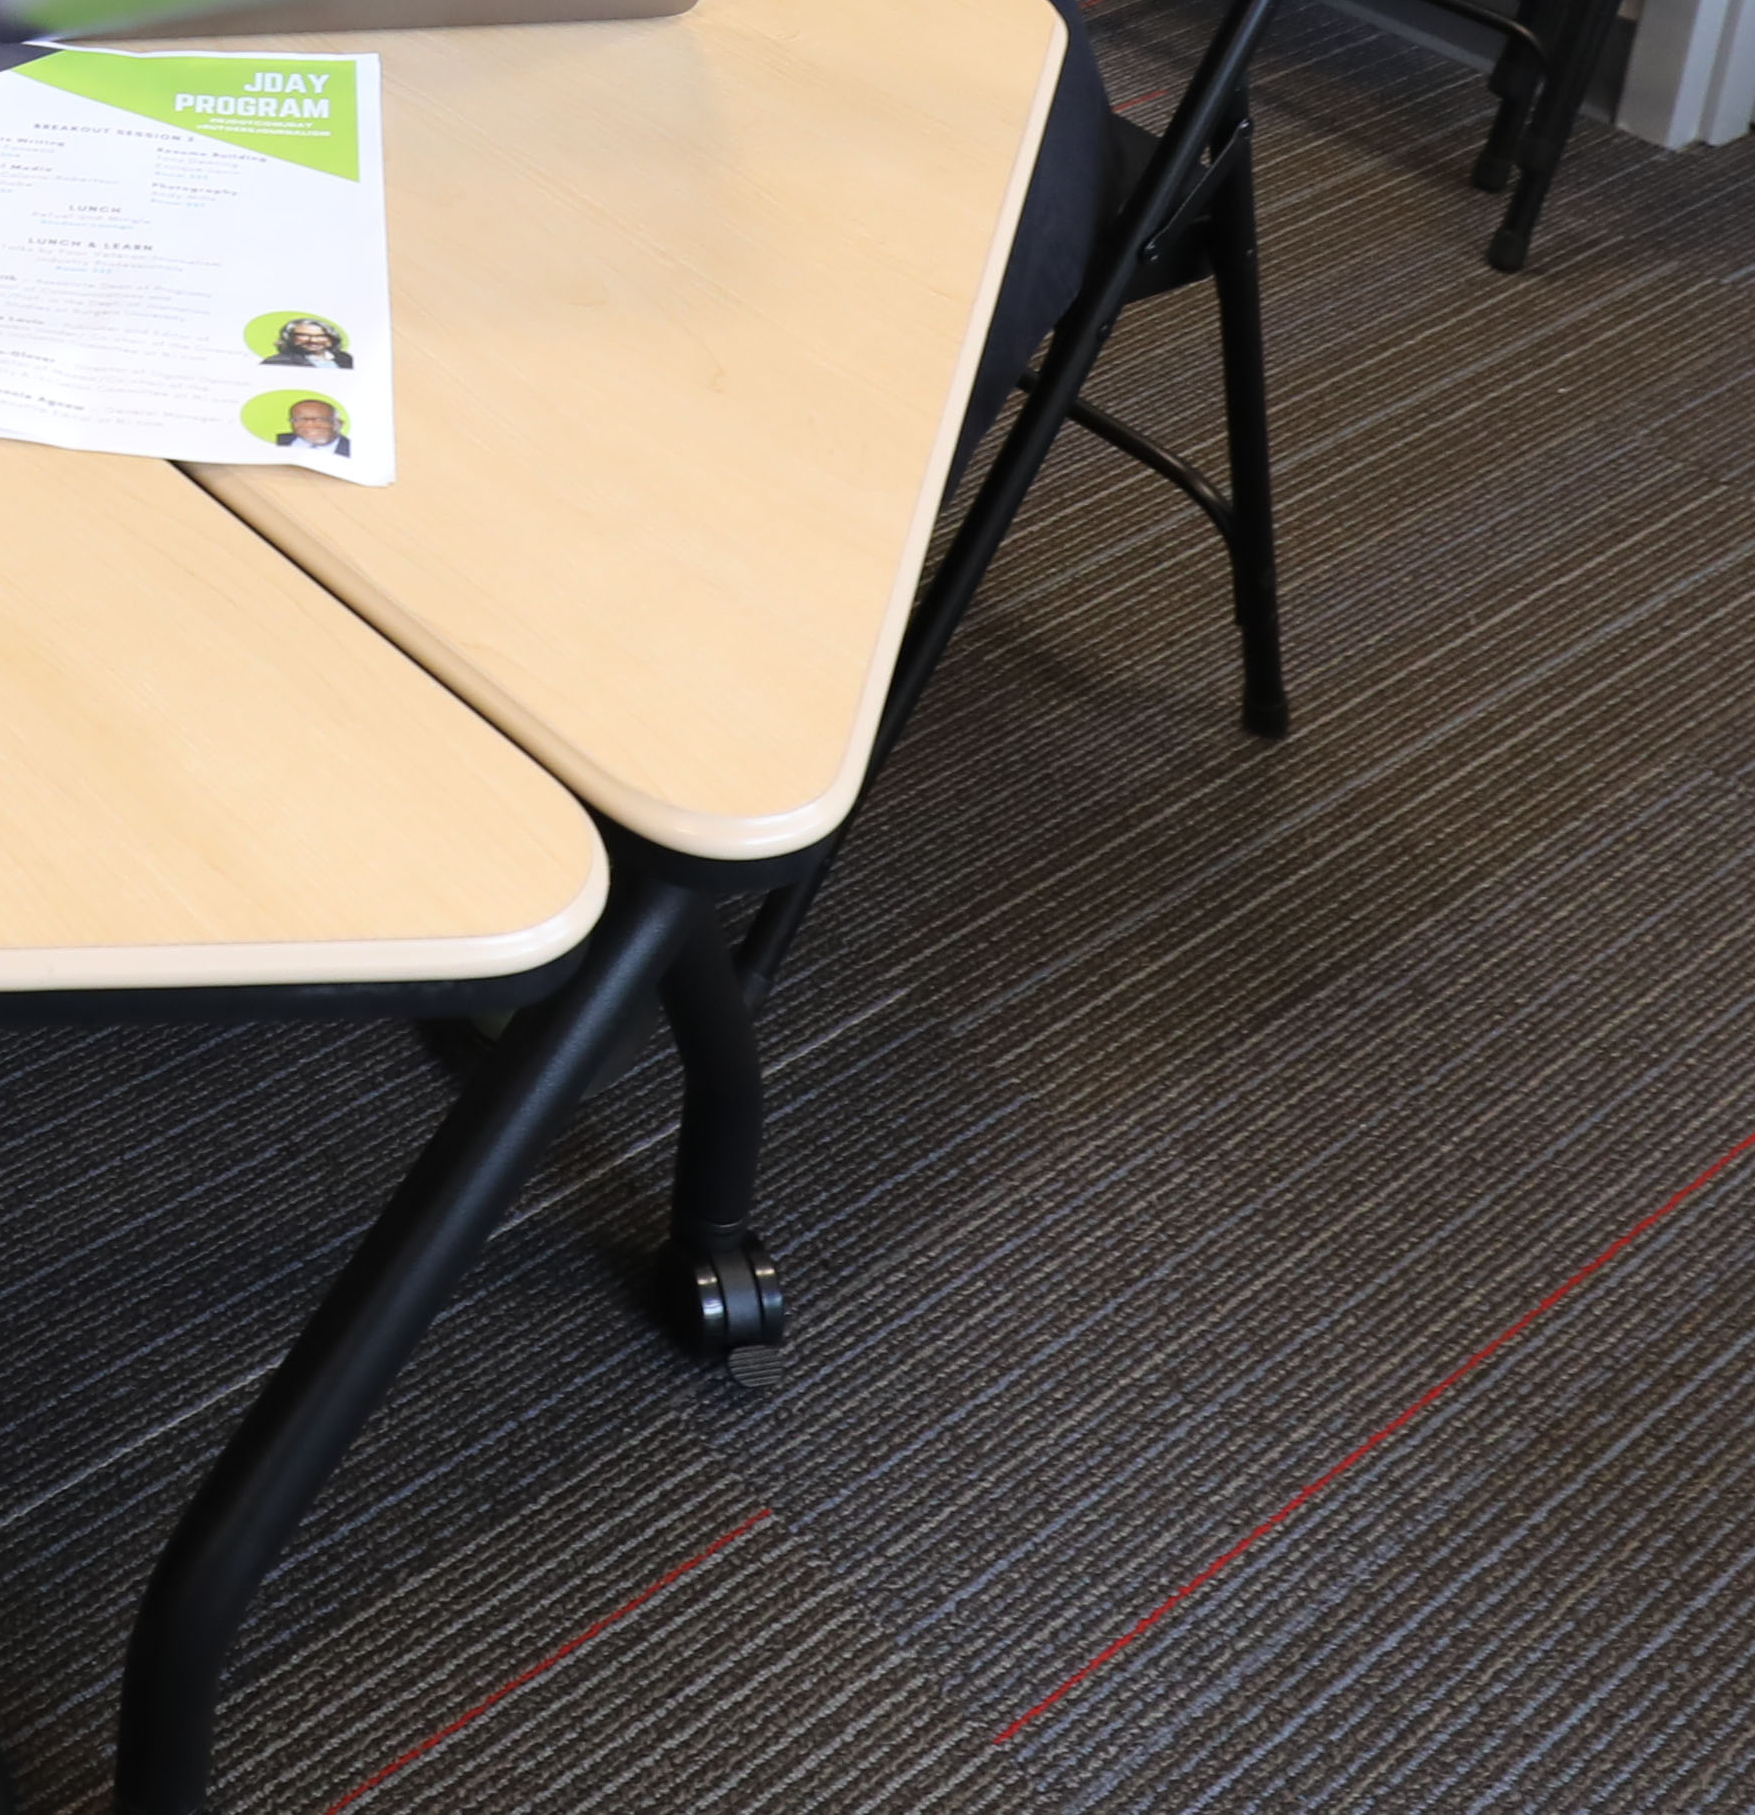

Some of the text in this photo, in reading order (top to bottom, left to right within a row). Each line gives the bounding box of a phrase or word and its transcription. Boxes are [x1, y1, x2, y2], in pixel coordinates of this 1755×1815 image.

[244, 72, 330, 94] JDAY
[175, 94, 330, 118] PROGRAM
[33, 123, 111, 134] BREAKOUT
[117, 129, 181, 141] SESSION
[17, 138, 65, 147] Writing
[10, 164, 52, 172] Media
[68, 204, 122, 213] LUNCH
[27, 237, 82, 247] LUNCH
[103, 243, 154, 251] LEARN
